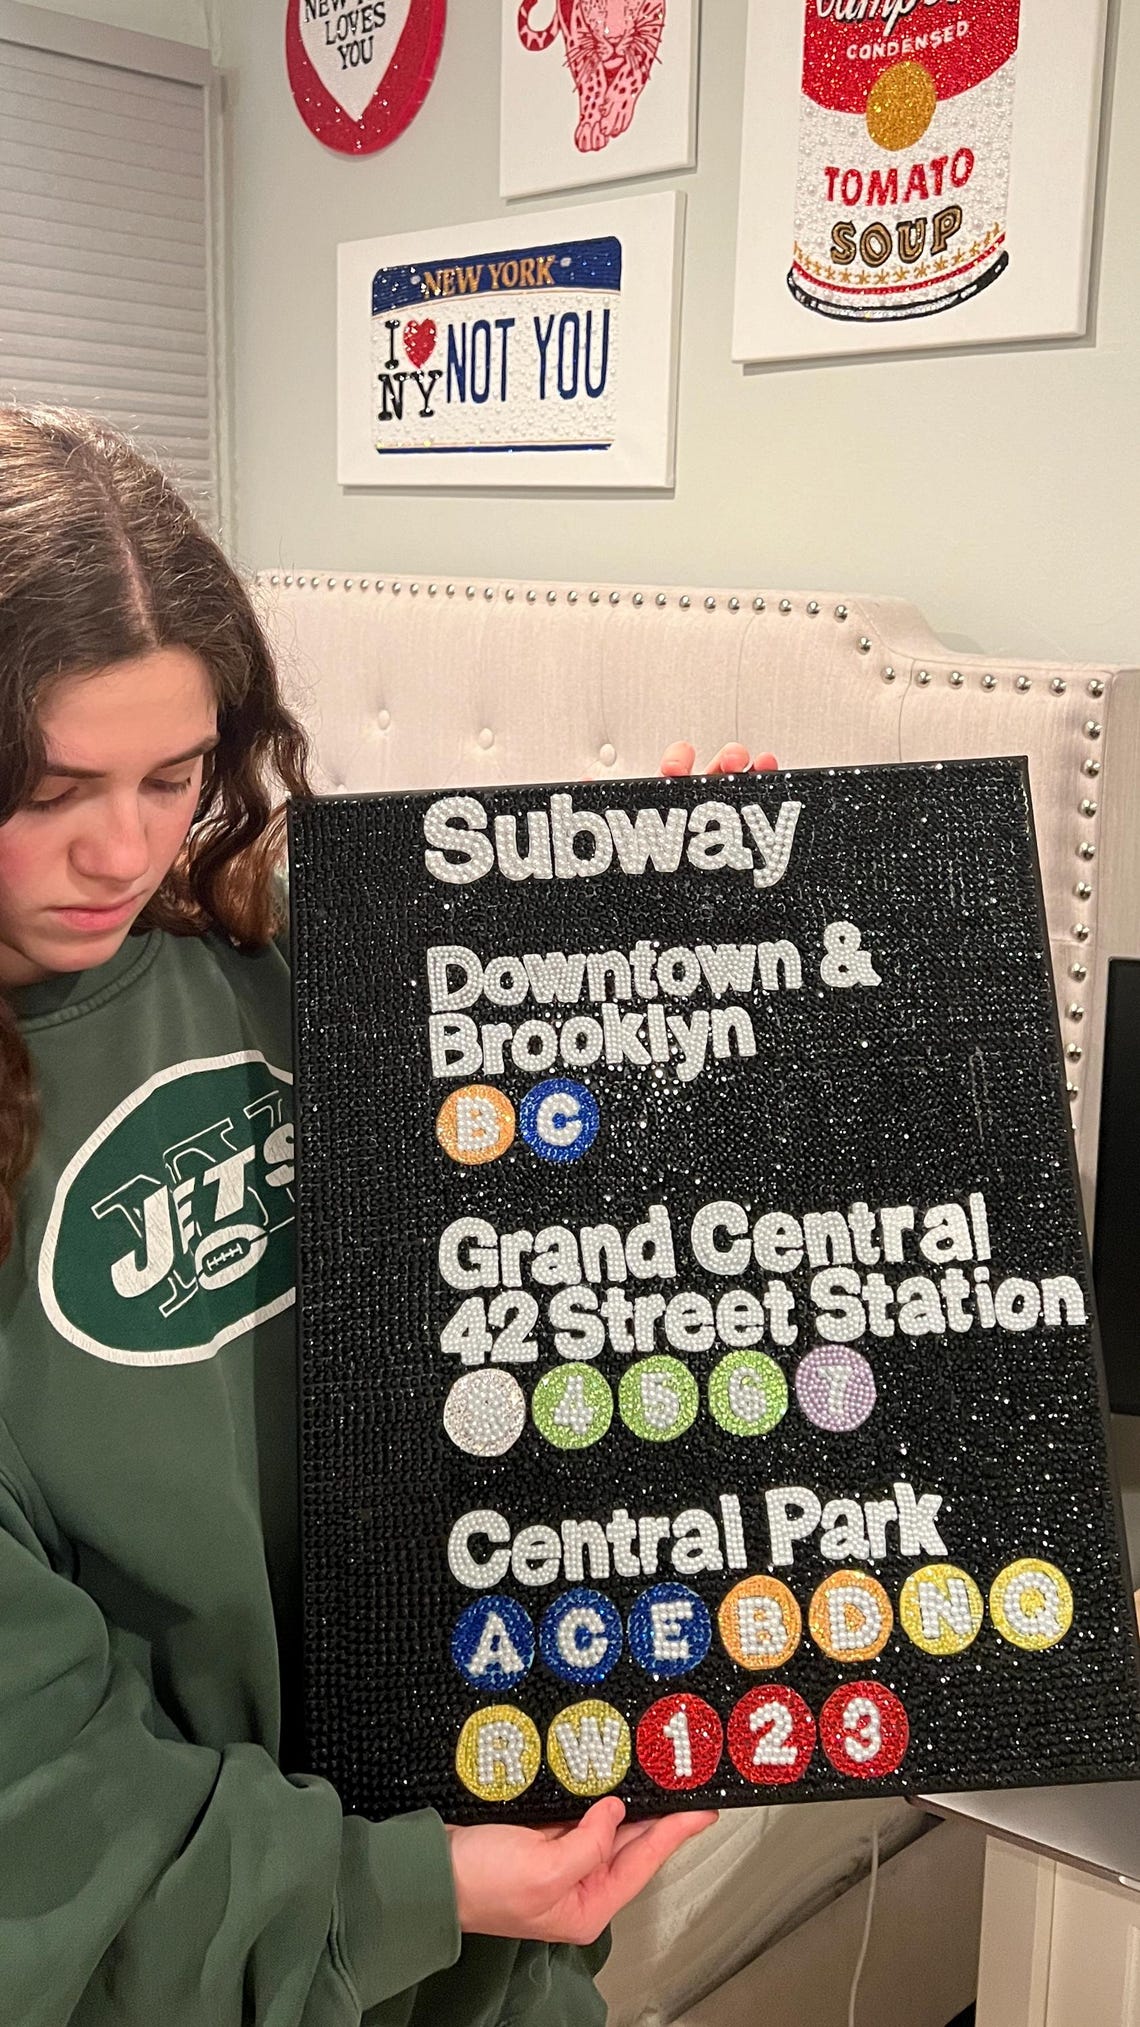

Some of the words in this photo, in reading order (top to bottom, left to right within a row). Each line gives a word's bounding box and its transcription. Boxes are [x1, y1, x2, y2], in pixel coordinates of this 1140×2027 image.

[324, 1, 386, 45] LOVES
[337, 35, 374, 70] YOU
[846, 20, 970, 60] CONDENSED
[824, 147, 975, 207] TOMATO
[830, 204, 963, 268] SOUP
[422, 265, 485, 299] NEW
[488, 255, 557, 290] YORK
[385, 319, 400, 370] I
[446, 317, 516, 404] NOT
[533, 308, 611, 401] YOU
[378, 370, 443, 421] NY
[423, 793, 801, 888] Subway
[426, 939, 802, 1012] Downtown
[820, 920, 882, 988] &
[428, 1002, 757, 1082] Brooklyn
[456, 1097, 500, 1151] B
[537, 1092, 583, 1147] C
[111, 1122, 295, 1298] JETS
[438, 1204, 676, 1290] Grand
[690, 1192, 991, 1276] Central
[440, 1289, 539, 1365] 42
[548, 1279, 798, 1361] Street
[809, 1266, 1087, 1343] Station
[553, 1375, 595, 1437] 4
[640, 1371, 680, 1431] 5
[728, 1365, 769, 1423] 6
[817, 1366, 853, 1416] 7
[447, 1493, 748, 1590] Central
[764, 1481, 949, 1567] Park
[467, 1613, 525, 1676] A
[556, 1606, 609, 1668] C
[649, 1600, 694, 1662] E
[738, 1596, 785, 1656] B
[827, 1586, 881, 1651] D
[916, 1577, 969, 1638] N
[1004, 1570, 1061, 1638] Q
[476, 1720, 523, 1785] R
[560, 1716, 620, 1784] W
[662, 1711, 693, 1778] 1
[749, 1703, 799, 1765] 2
[842, 1696, 883, 1763] 3
